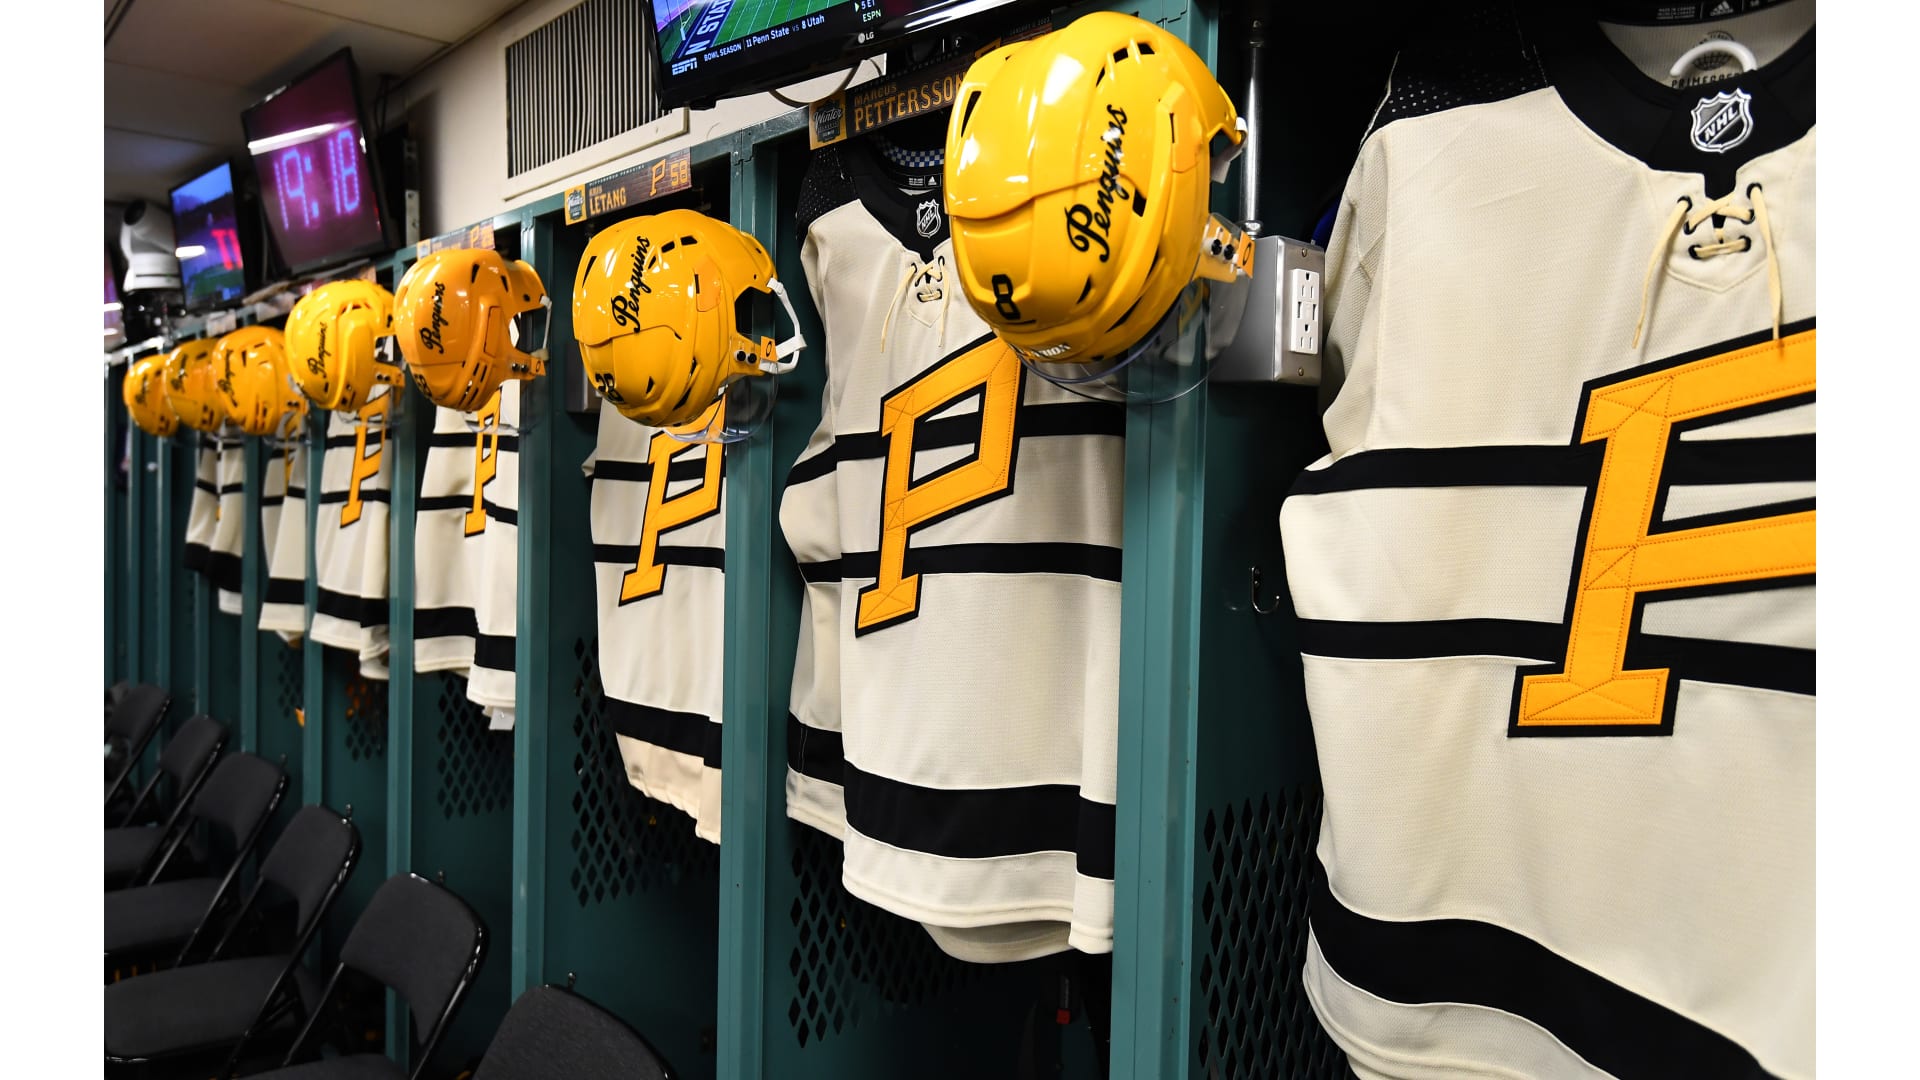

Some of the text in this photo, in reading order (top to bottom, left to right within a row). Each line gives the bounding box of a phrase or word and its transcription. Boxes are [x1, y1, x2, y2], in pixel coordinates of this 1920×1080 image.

[862, 9, 882, 22] ESPN
[703, 51, 720, 62] BOWL
[720, 43, 742, 57] SEASON
[746, 39, 752, 48] 11
[753, 33, 770, 45] Penn
[770, 26, 790, 39] State
[801, 20, 807, 30] 8
[807, 14, 825, 28] Utah
[865, 31, 875, 41] LG
[672, 57, 698, 76] ESPN
[854, 82, 897, 106] MARCUS
[1704, 105, 1739, 142] NHL
[649, 159, 688, 196] P 58
[1064, 104, 1130, 263] Penguins
[589, 187, 627, 215] LETANG
[611, 235, 651, 333] Penguins
[992, 274, 1021, 320] 8
[419, 282, 449, 354] Penguins
[855, 331, 1028, 638] P
